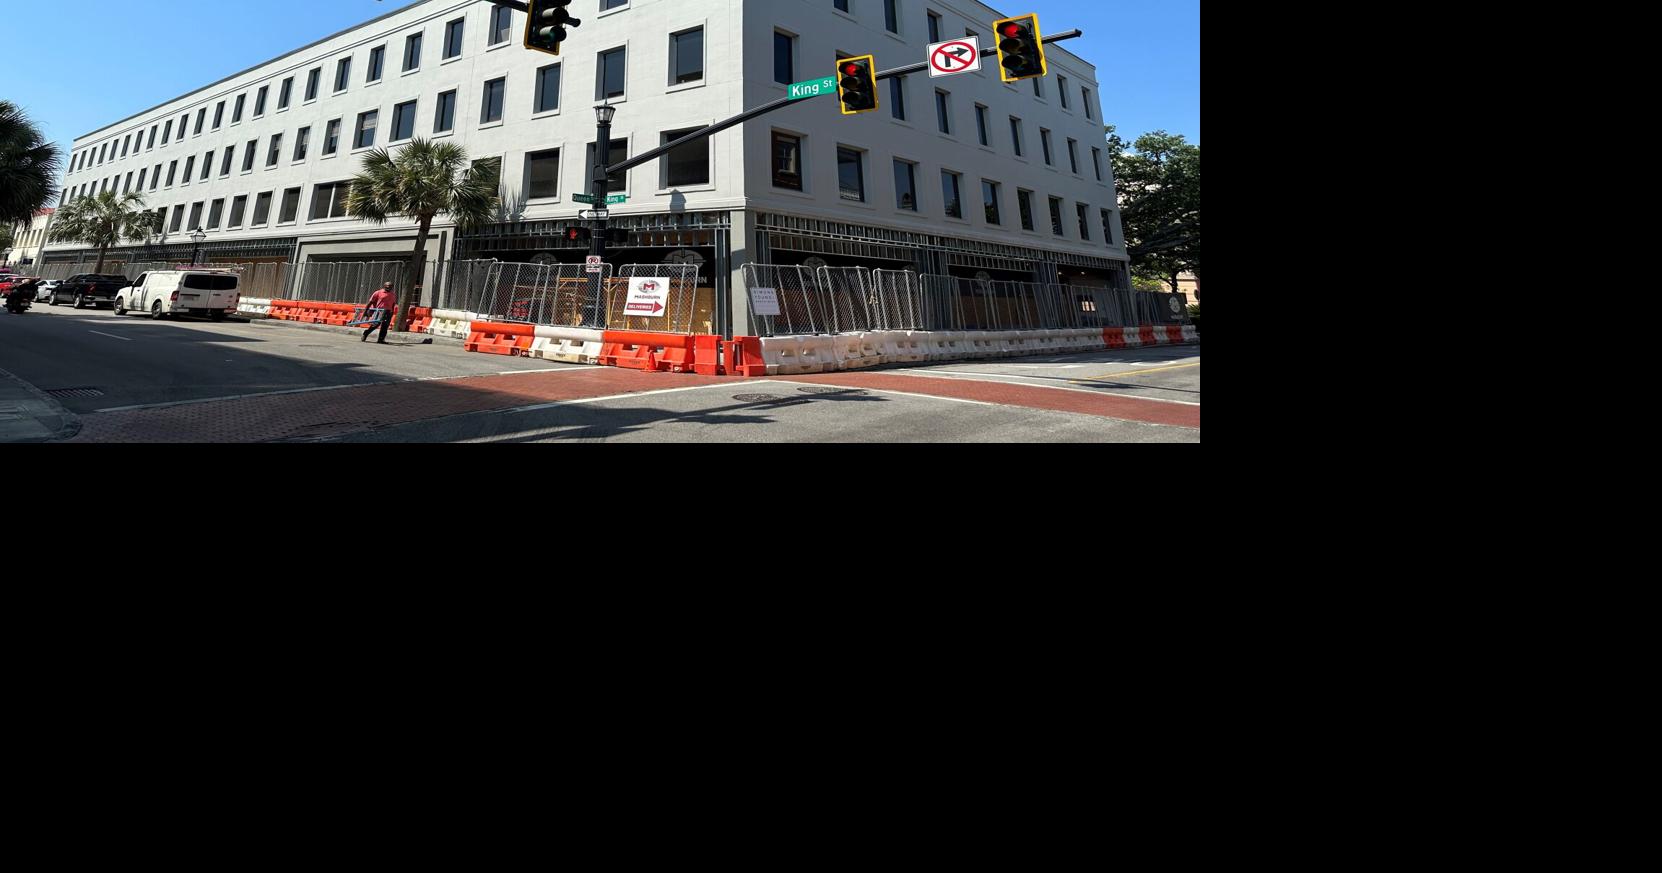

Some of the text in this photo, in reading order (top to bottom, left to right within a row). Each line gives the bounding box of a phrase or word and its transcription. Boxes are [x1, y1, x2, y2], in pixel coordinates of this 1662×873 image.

[792, 80, 833, 97] King St
[643, 283, 655, 291] M
